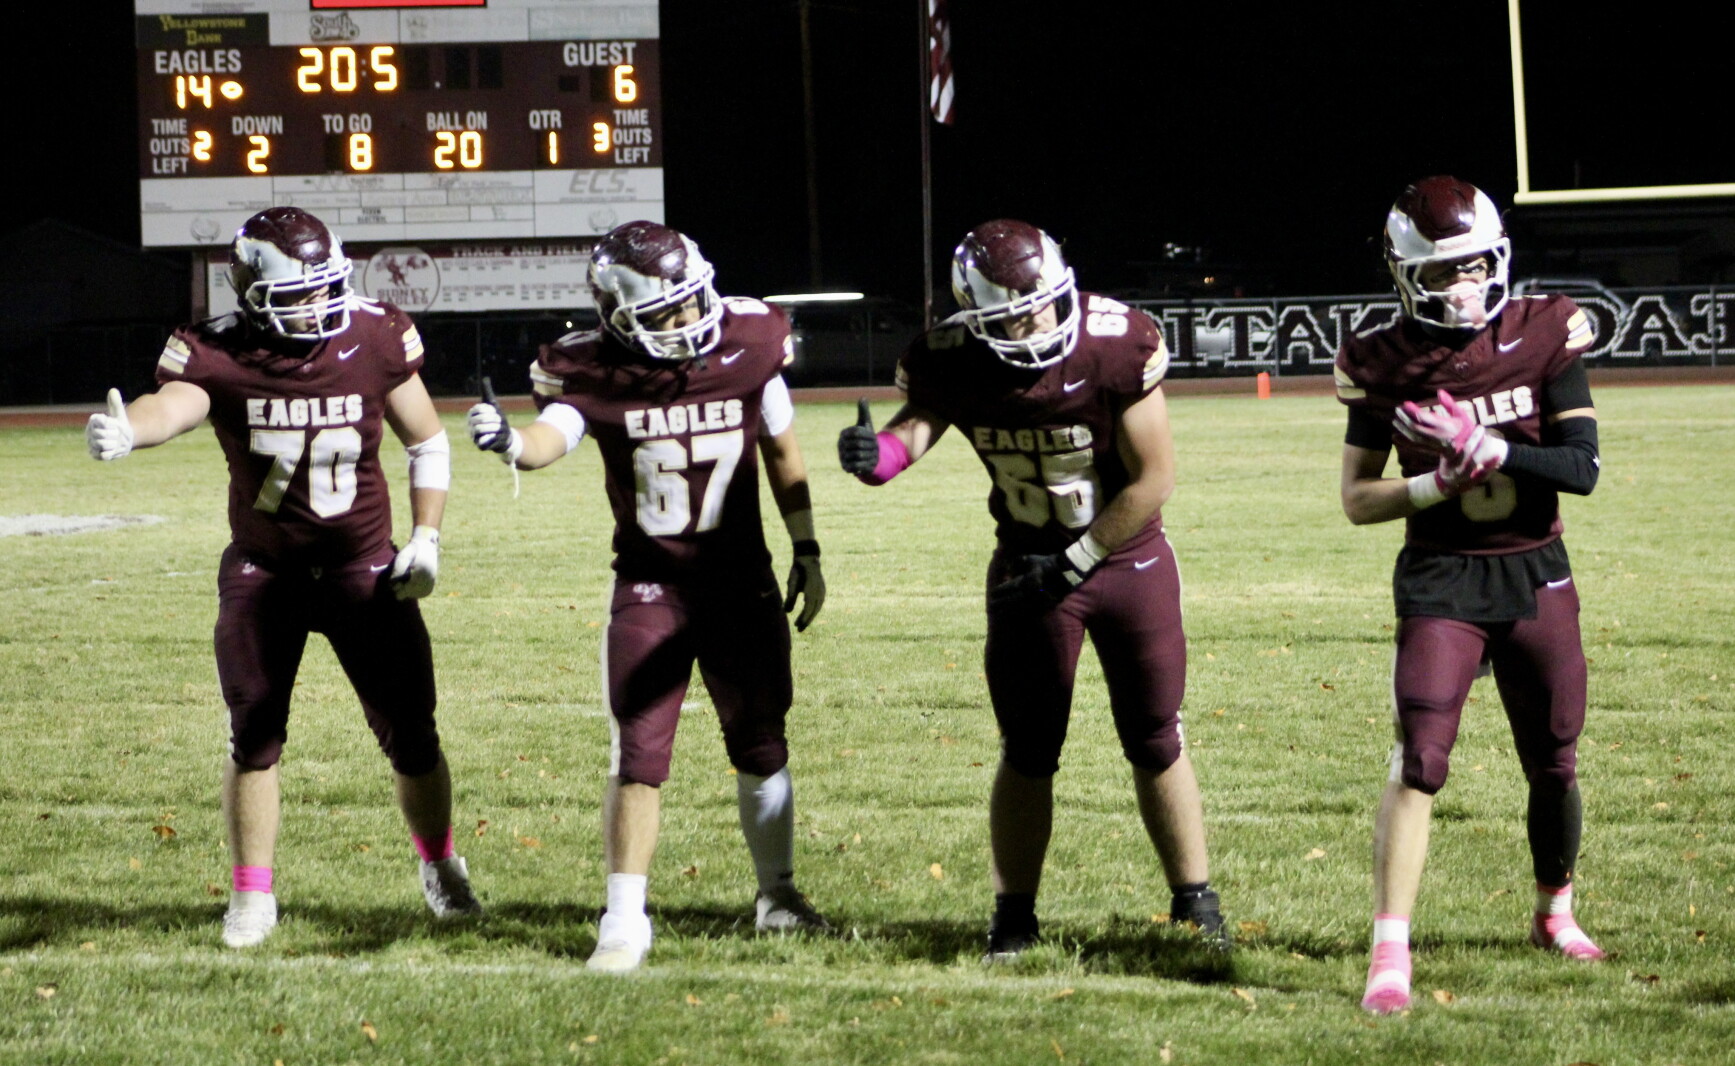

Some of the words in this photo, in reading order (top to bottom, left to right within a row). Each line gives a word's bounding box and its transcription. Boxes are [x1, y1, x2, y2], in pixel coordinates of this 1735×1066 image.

[155, 49, 242, 74] EAGLES
[563, 42, 637, 66] GUEST
[175, 75, 212, 110] 14
[613, 64, 637, 103] 6
[151, 118, 187, 135] TIME
[231, 115, 284, 136] DOWN
[322, 114, 344, 133] TO
[348, 113, 372, 133] GO
[426, 112, 463, 131] BALL
[465, 111, 488, 130] ON
[528, 109, 562, 129] QTR
[613, 109, 649, 126] TIME
[150, 138, 190, 155] OUTS
[192, 130, 213, 161] 2
[433, 130, 483, 169] 20
[548, 131, 558, 165] 1
[592, 121, 610, 152] 3
[612, 128, 652, 145] OUTS
[246, 134, 270, 173] 2
[348, 132, 373, 171] 8
[614, 147, 651, 164] LEFT
[152, 157, 189, 174] LEFT
[568, 169, 629, 194] ECS
[246, 394, 363, 426] EAGLES
[624, 399, 743, 438] EAGLES
[972, 424, 1094, 450] EAGLES
[249, 426, 363, 519] 70
[632, 429, 744, 537] 67
[986, 448, 1095, 529] 65
